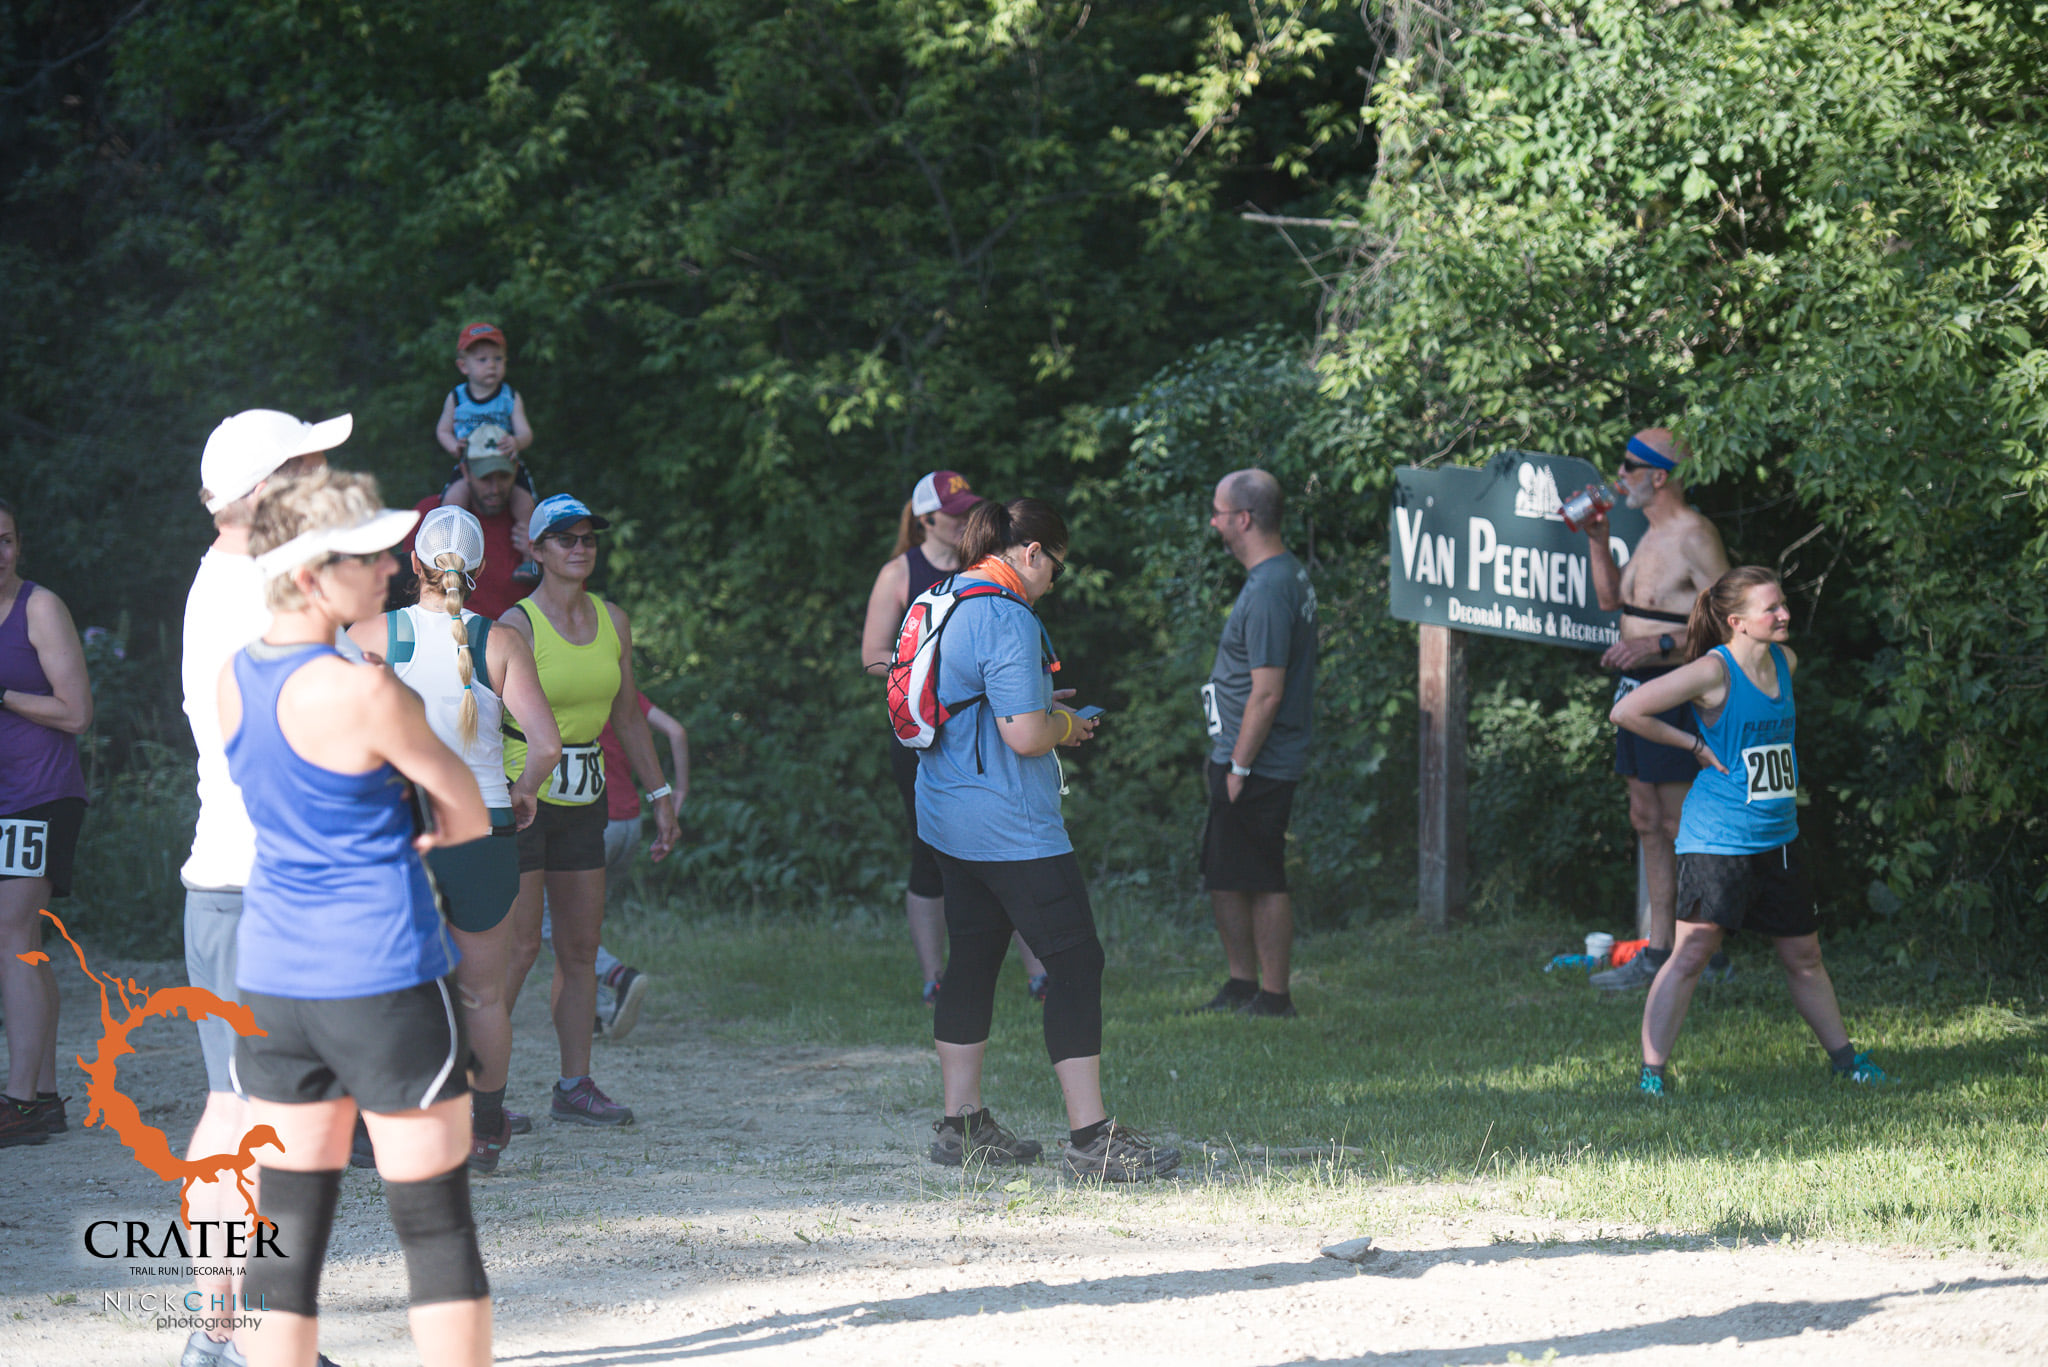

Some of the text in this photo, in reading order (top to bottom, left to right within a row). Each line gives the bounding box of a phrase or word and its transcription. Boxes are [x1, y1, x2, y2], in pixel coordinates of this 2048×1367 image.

[1395, 506, 1587, 608] VAN PEENEN
[1544, 611, 1557, 637] &
[558, 752, 602, 796] 178
[1748, 748, 1795, 793] 209
[0, 824, 44, 870] 15
